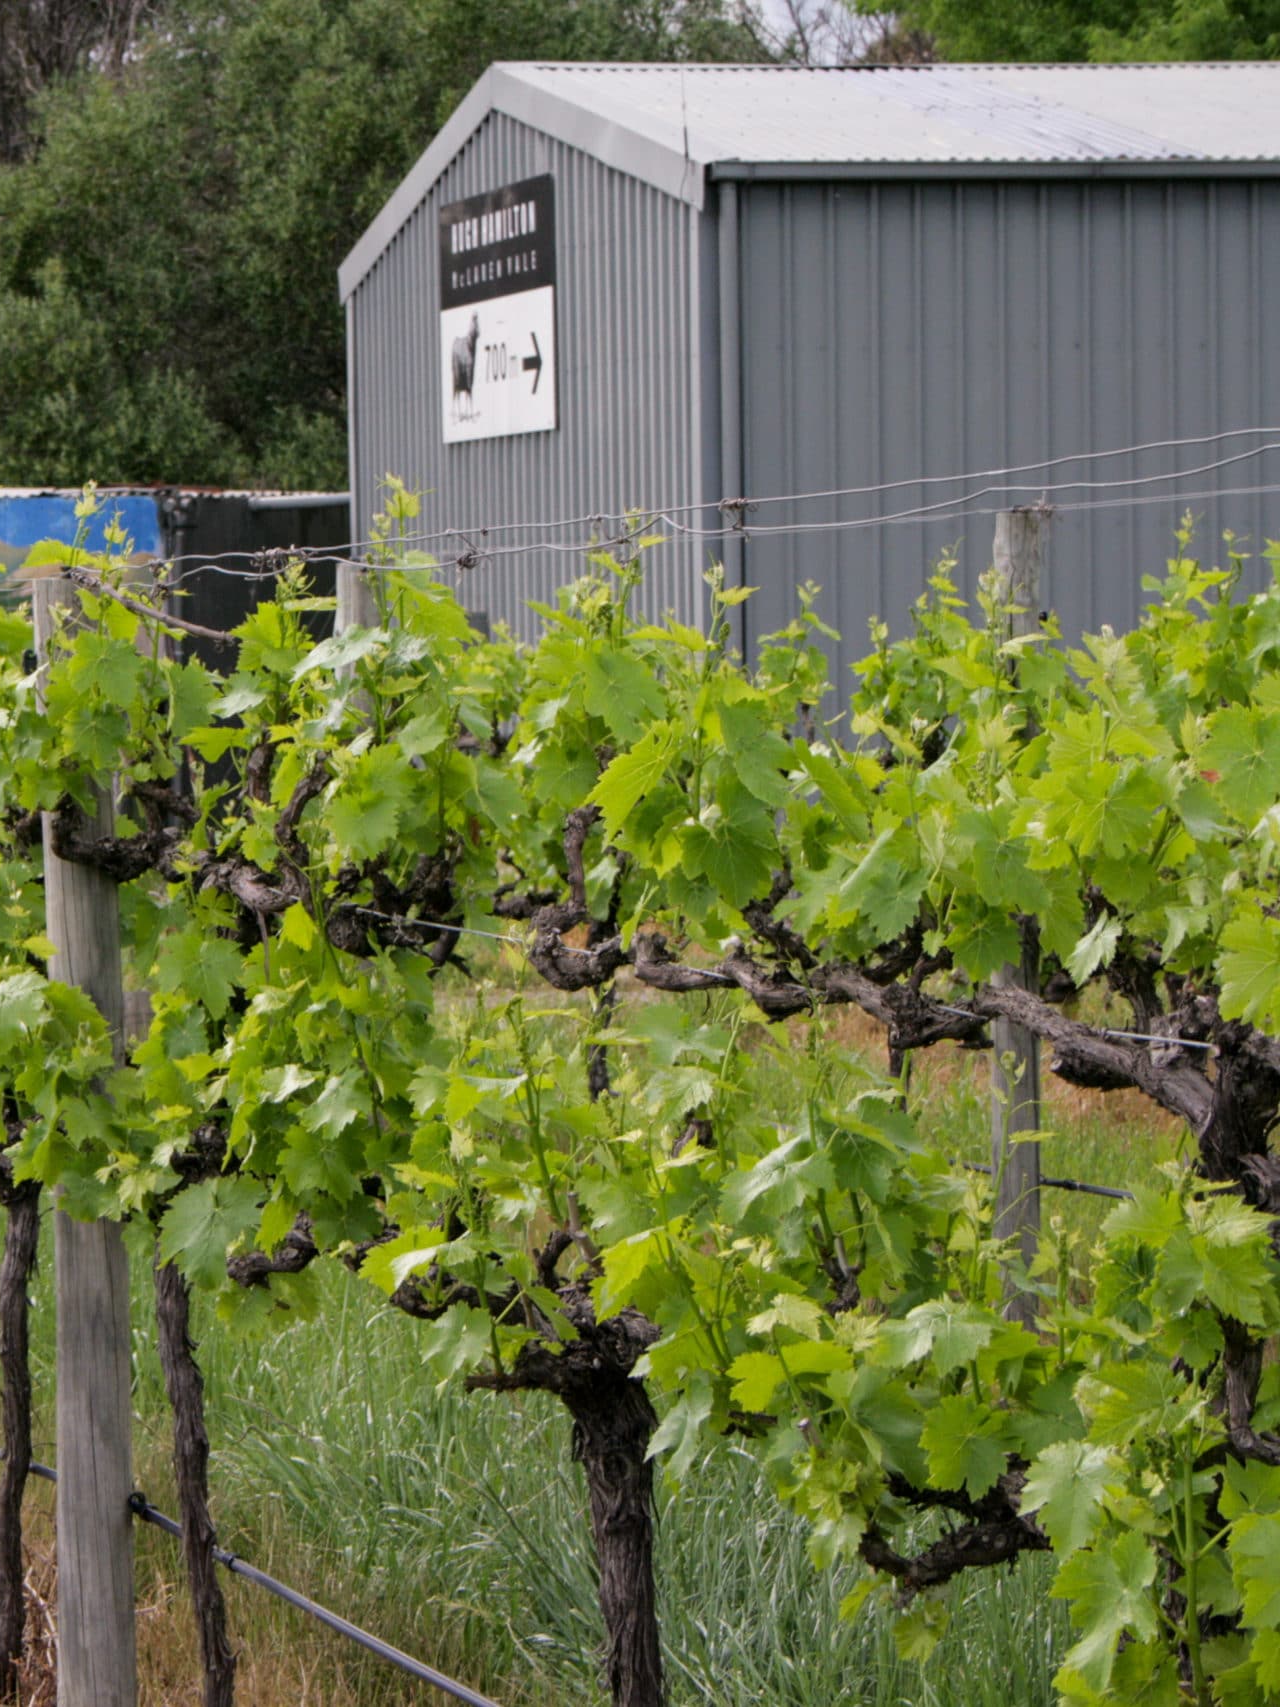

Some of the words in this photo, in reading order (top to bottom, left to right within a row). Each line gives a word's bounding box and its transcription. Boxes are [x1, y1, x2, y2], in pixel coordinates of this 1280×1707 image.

[481, 200, 536, 247] HAMILTON
[507, 249, 537, 277] VALE
[484, 342, 507, 384] 700
